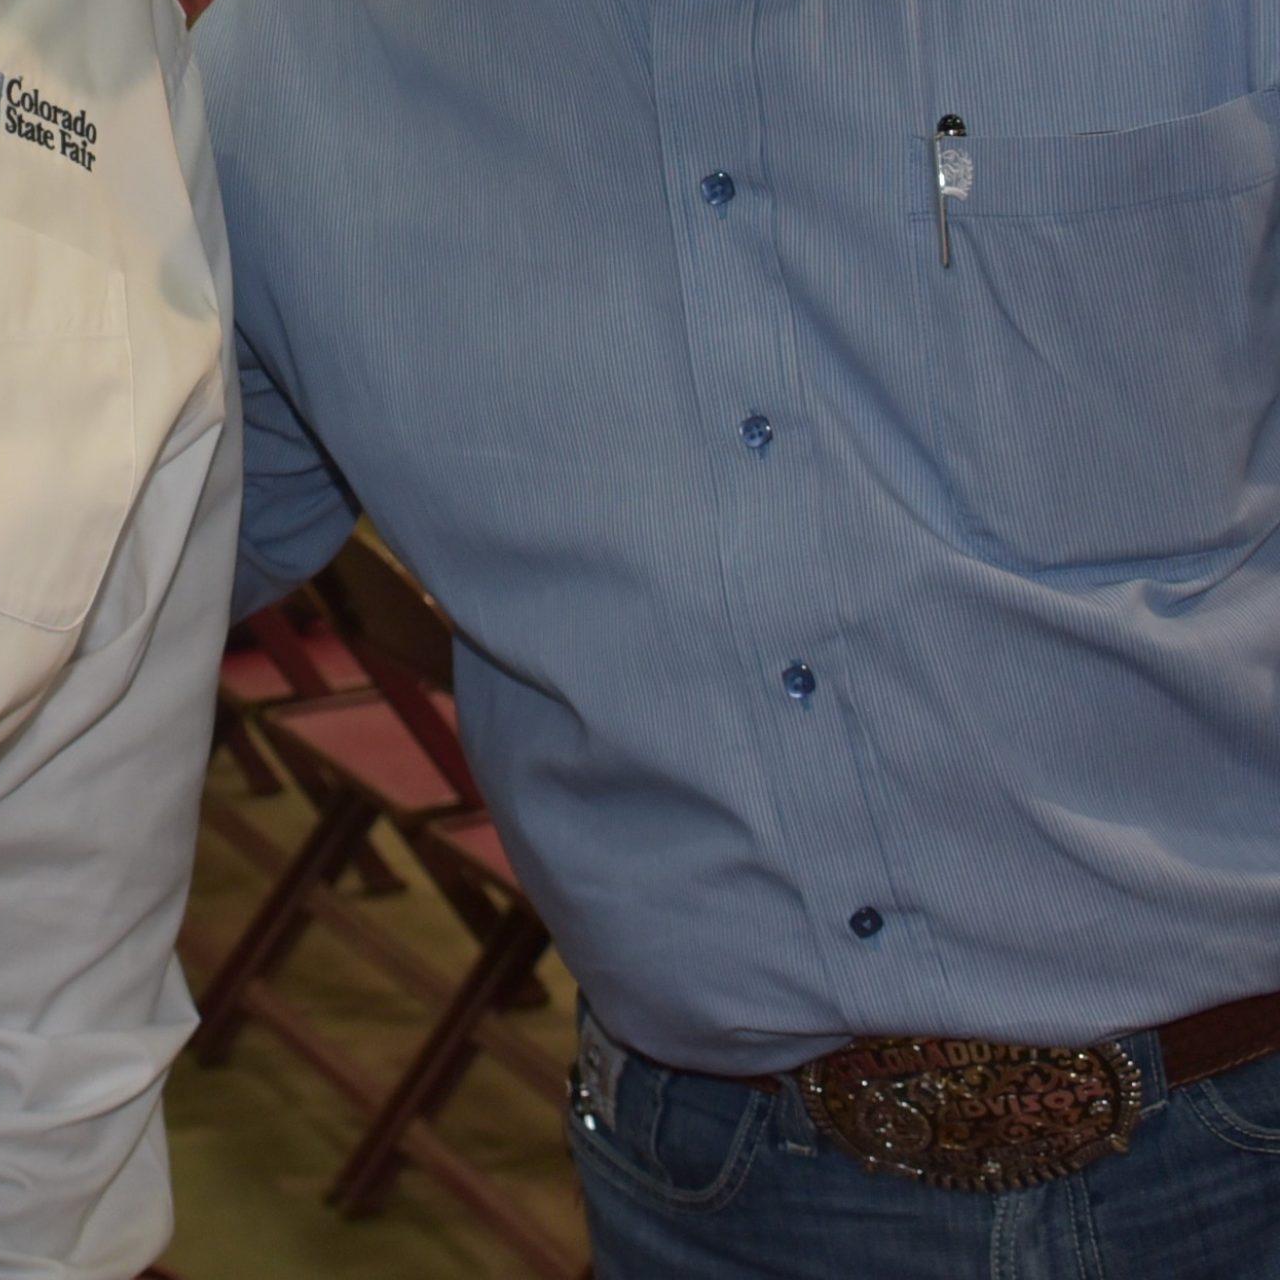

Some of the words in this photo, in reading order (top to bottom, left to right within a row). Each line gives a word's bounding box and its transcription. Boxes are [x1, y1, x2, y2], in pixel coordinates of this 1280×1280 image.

[5, 106, 55, 151] State
[59, 129, 96, 172] Fair
[6, 76, 97, 145] Colorado
